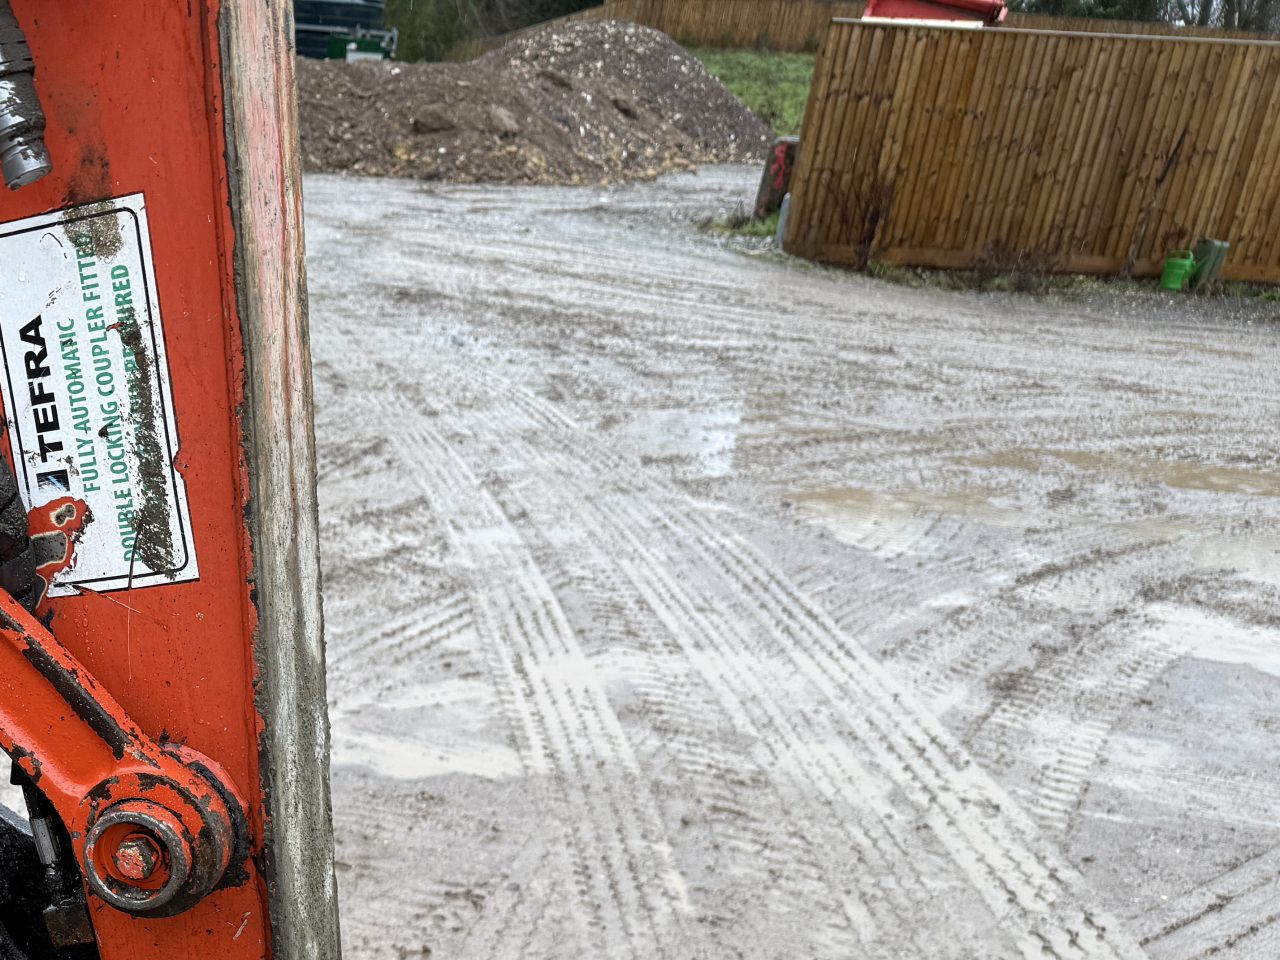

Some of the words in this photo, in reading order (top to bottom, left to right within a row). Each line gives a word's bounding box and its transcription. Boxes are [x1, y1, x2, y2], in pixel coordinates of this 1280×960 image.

[75, 233, 101, 302] FITTED
[19, 314, 64, 463] TEFRA
[57, 318, 92, 434] AUTOMATIC
[86, 305, 115, 397] COUPLER
[75, 437, 101, 492] FULLY
[100, 401, 130, 484] LOCKING
[114, 488, 142, 562] DOUBLE
